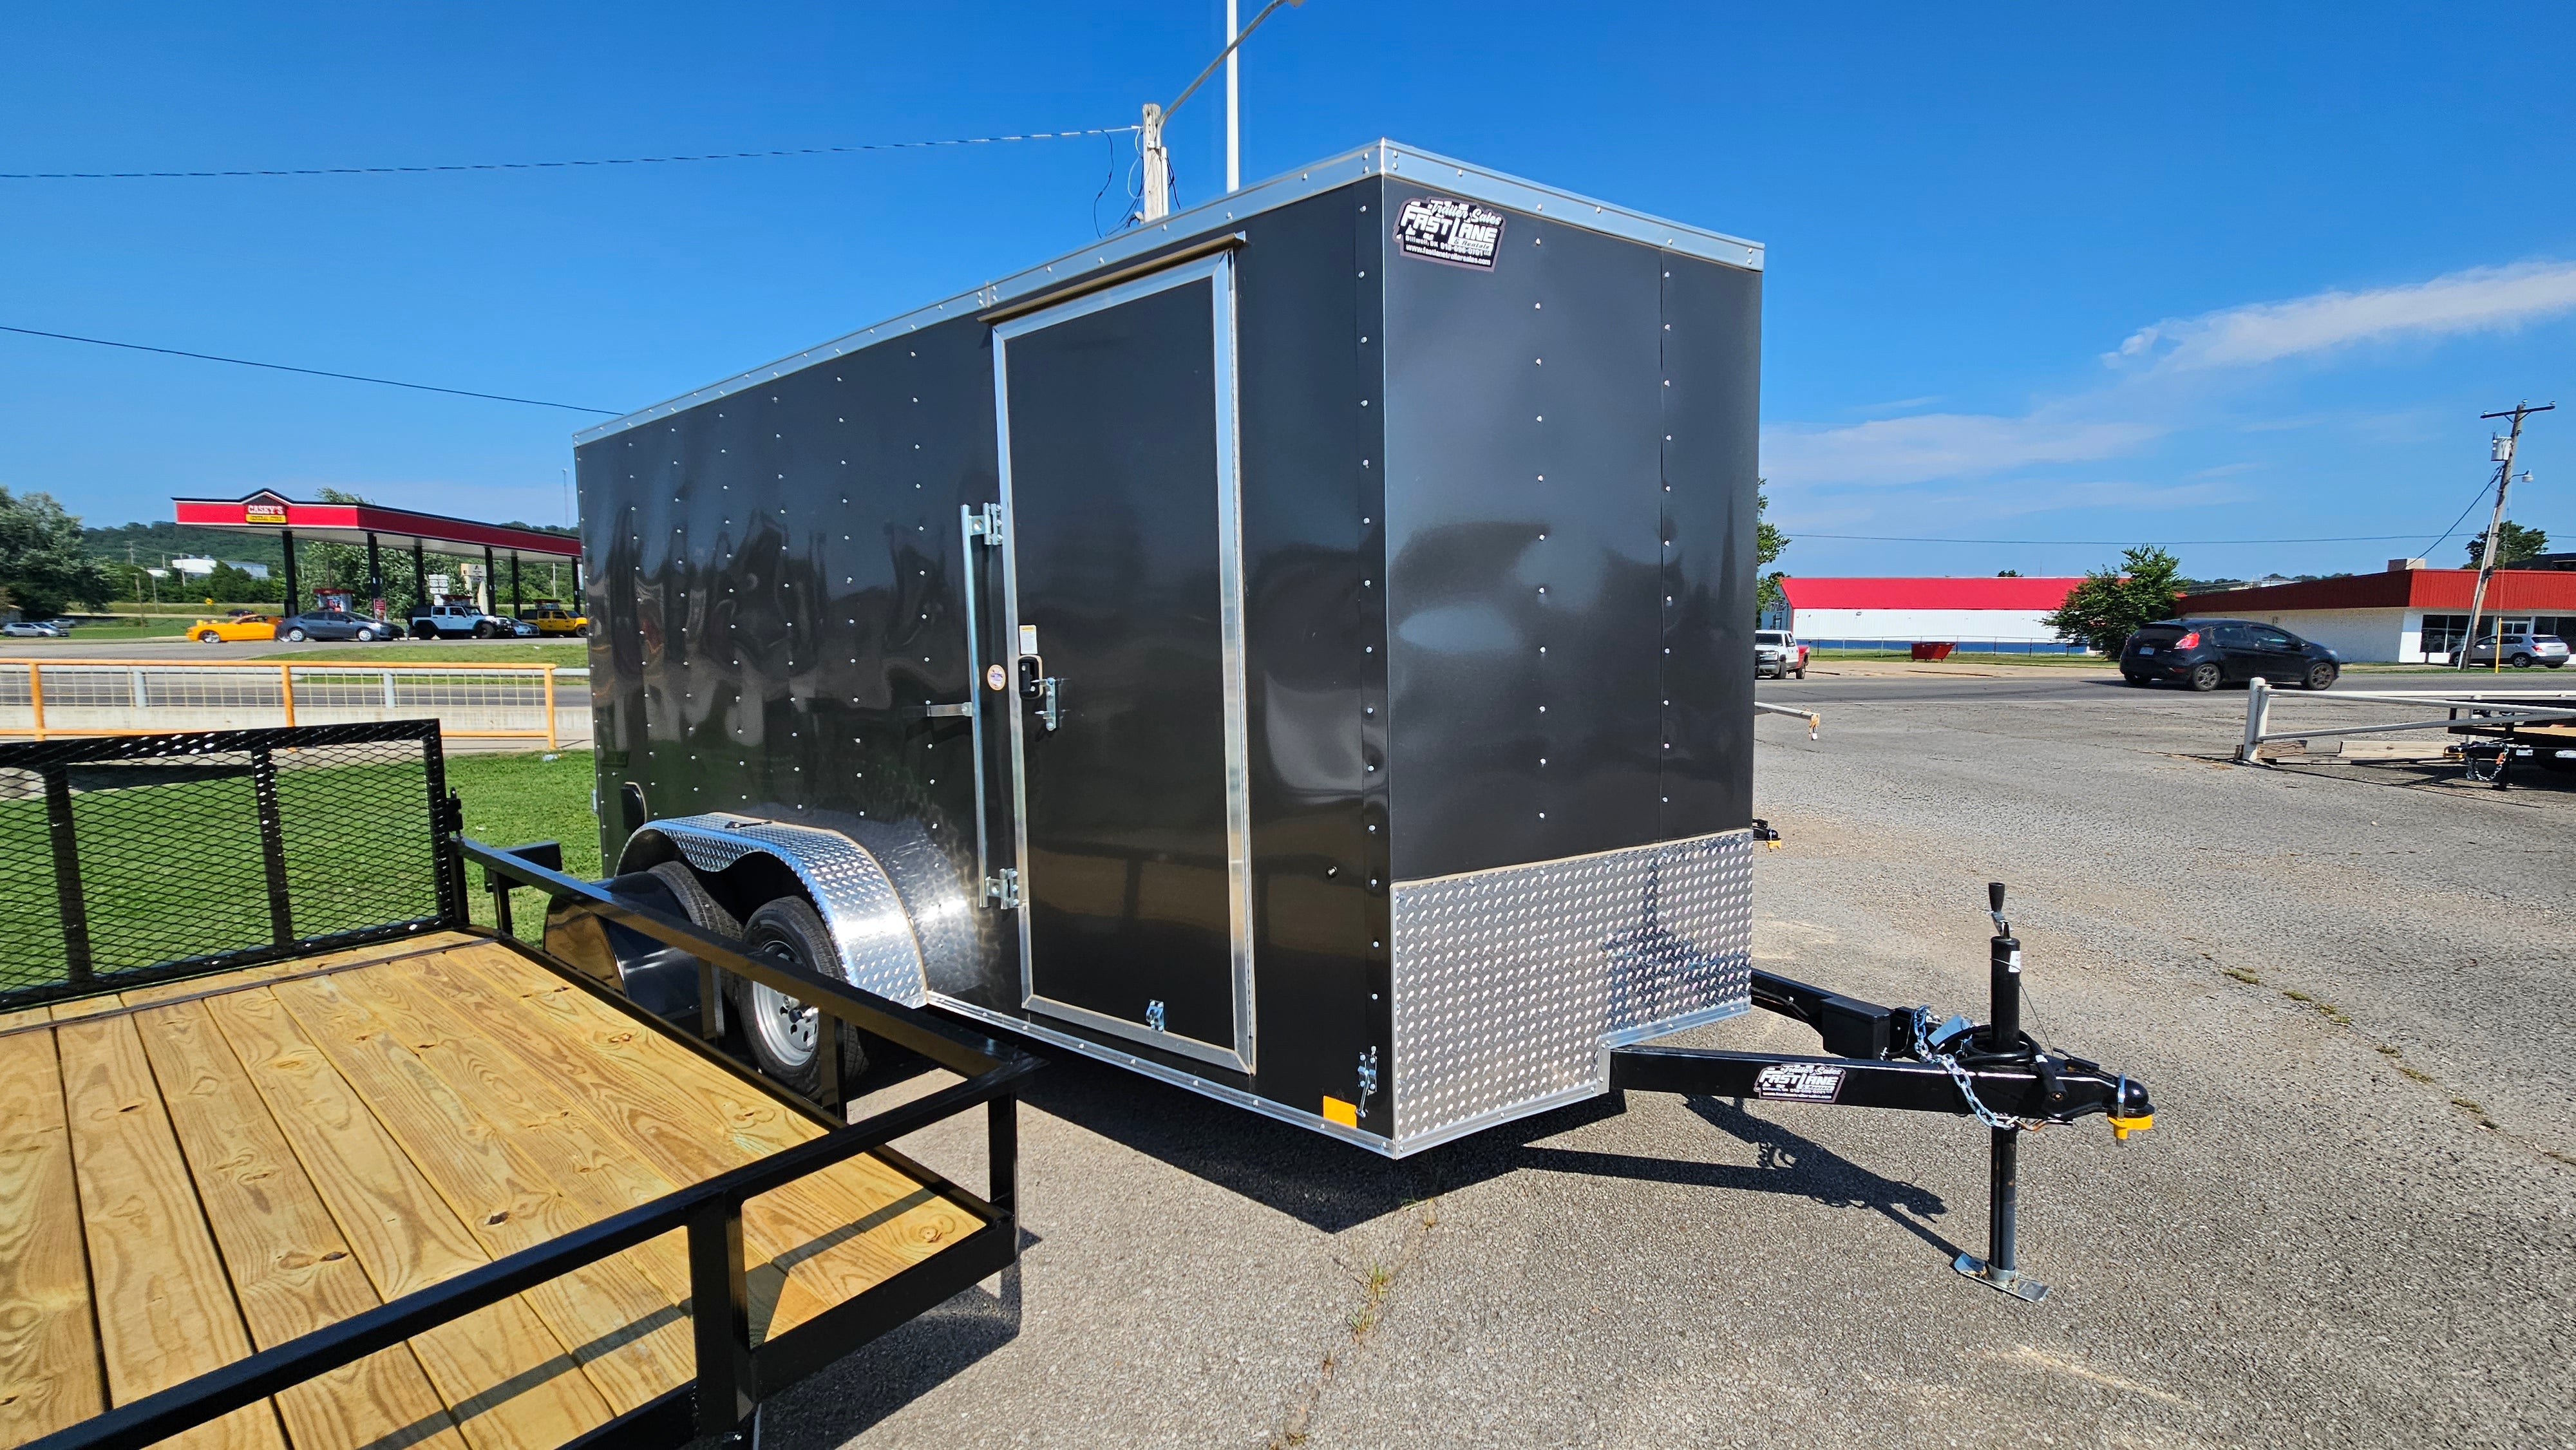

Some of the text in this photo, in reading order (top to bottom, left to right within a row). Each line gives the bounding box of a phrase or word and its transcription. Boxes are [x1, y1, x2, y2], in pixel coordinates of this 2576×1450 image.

[1430, 200, 1502, 225] Trailer Sales
[1401, 203, 1498, 244] FAST LANE
[248, 505, 283, 514] CASEY'S
[1759, 1070, 1839, 1089] FAST LANE
[1783, 1065, 1842, 1075] Trailer Sales
